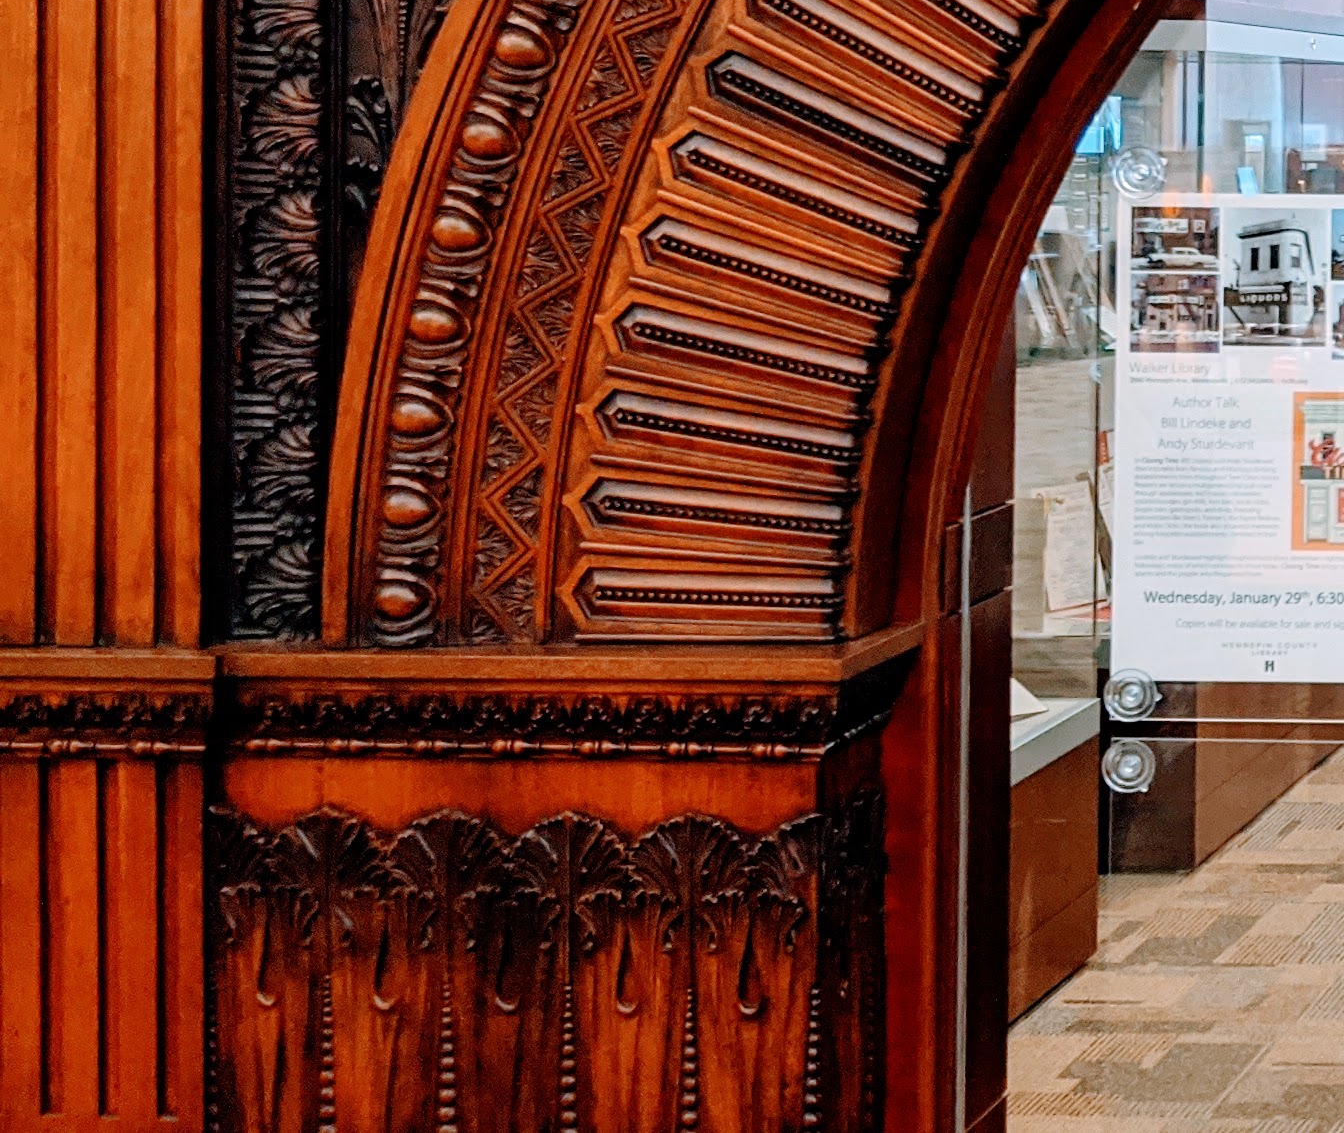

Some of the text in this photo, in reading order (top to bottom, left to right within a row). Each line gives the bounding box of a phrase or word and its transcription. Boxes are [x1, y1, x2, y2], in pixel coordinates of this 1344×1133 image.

[1129, 362, 1210, 376] Walker Library
[1172, 396, 1240, 409] Author Talk
[1161, 417, 1252, 429] Bill Lindeke and
[1157, 438, 1255, 452] Andy Sturdevant
[1143, 591, 1227, 606] Wednesday,
[1229, 591, 1281, 607] January
[1175, 618, 1206, 630] Copies
[1208, 619, 1223, 628] will
[1225, 619, 1236, 628] be
[1239, 619, 1278, 628] available
[1280, 619, 1292, 628] for
[1294, 619, 1311, 628] sale
[1314, 619, 1330, 628] and
